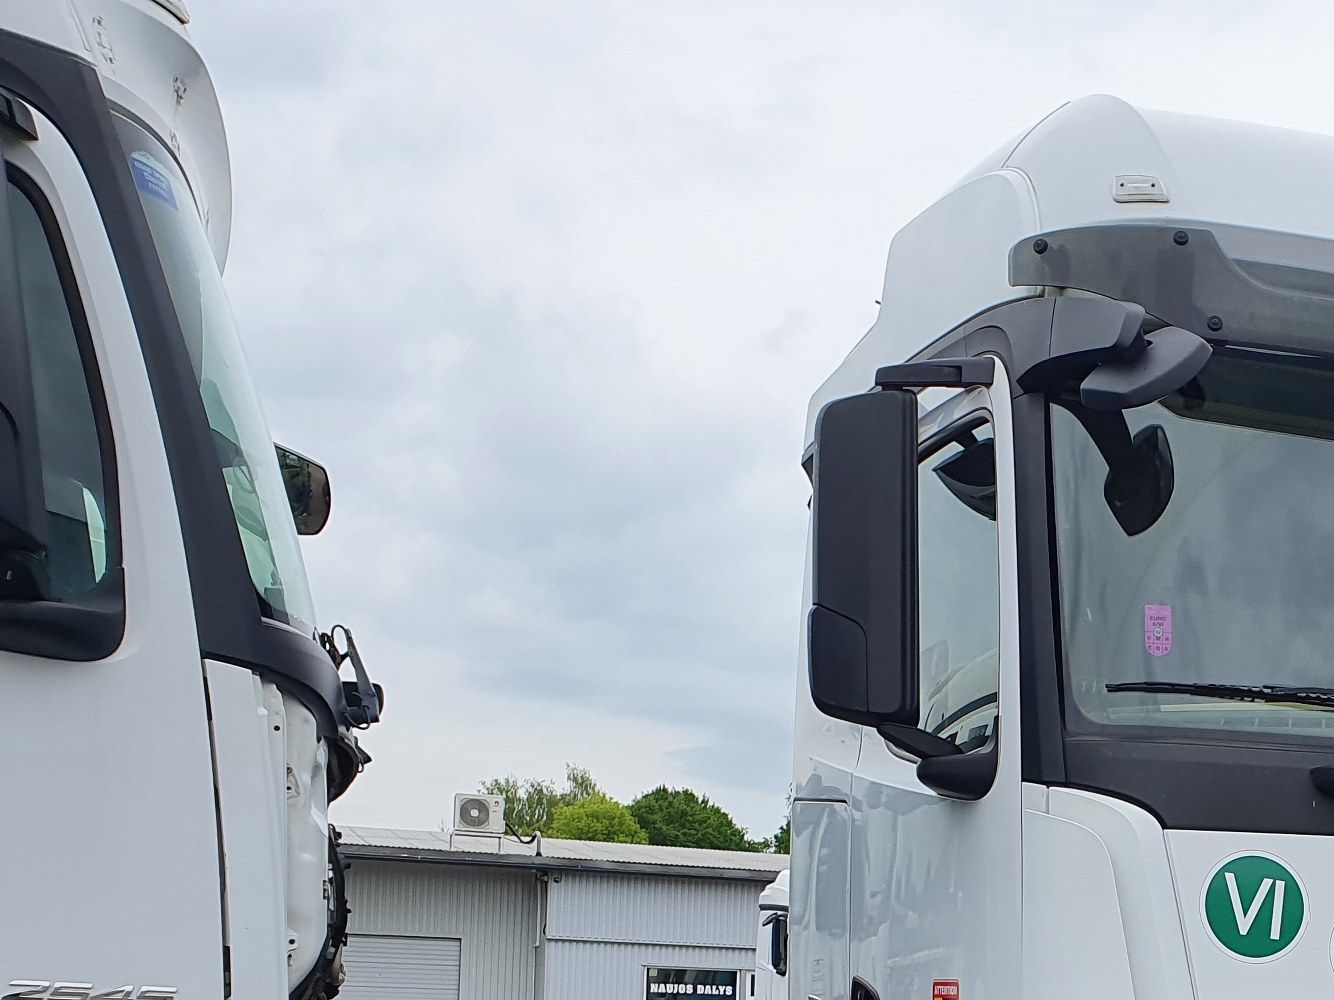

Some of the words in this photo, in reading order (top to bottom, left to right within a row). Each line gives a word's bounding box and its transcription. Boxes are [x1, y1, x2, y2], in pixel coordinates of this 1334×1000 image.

[1224, 872, 1286, 940] VI
[650, 983, 694, 994] NAUJOS
[696, 984, 733, 996] DALYS
